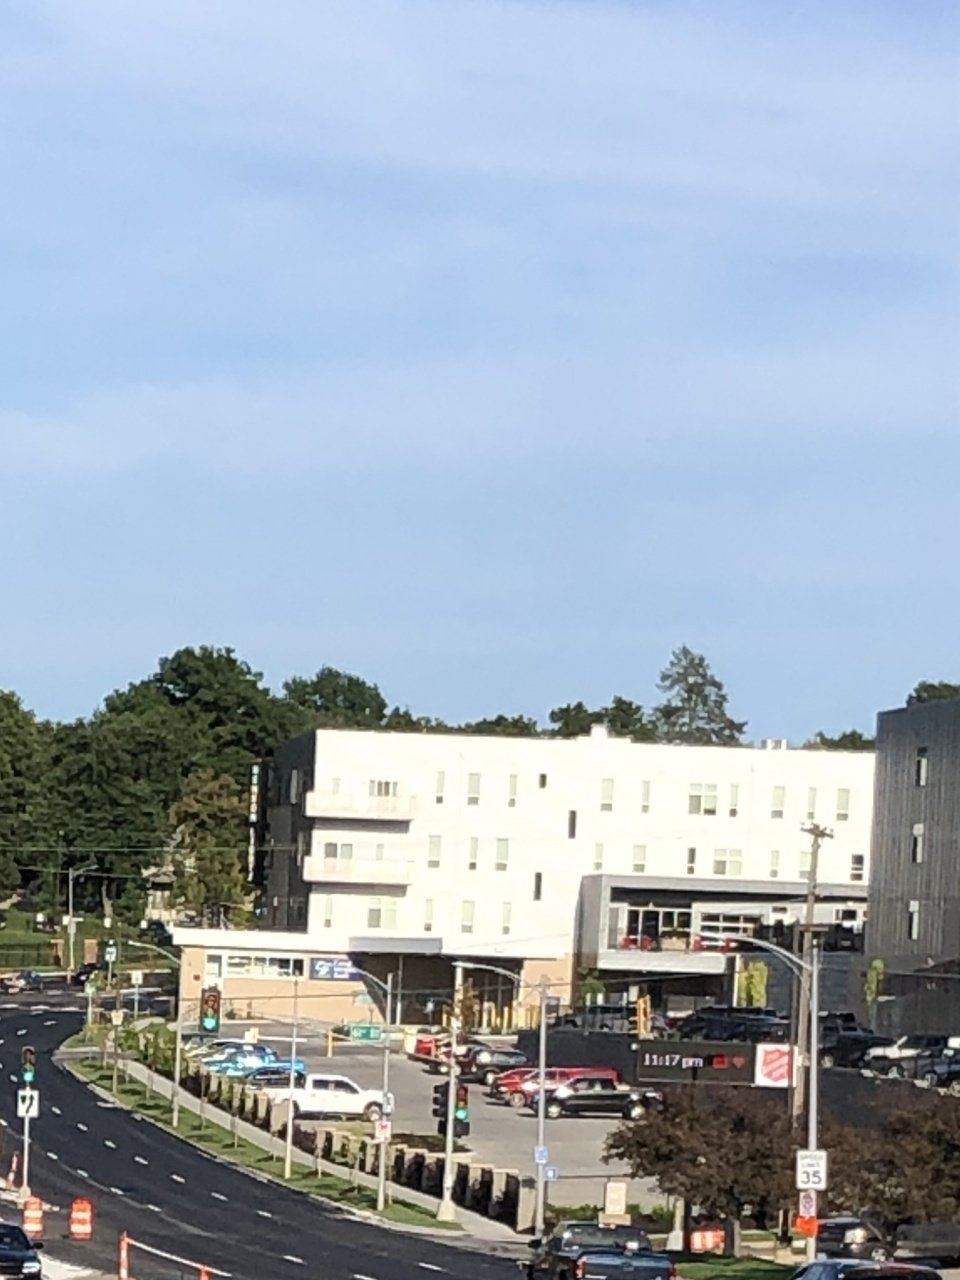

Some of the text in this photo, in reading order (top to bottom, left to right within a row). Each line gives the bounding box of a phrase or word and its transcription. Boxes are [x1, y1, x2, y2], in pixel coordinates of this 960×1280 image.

[643, 1053, 704, 1069] 11:17 pm
[800, 1170, 822, 1185] 35
